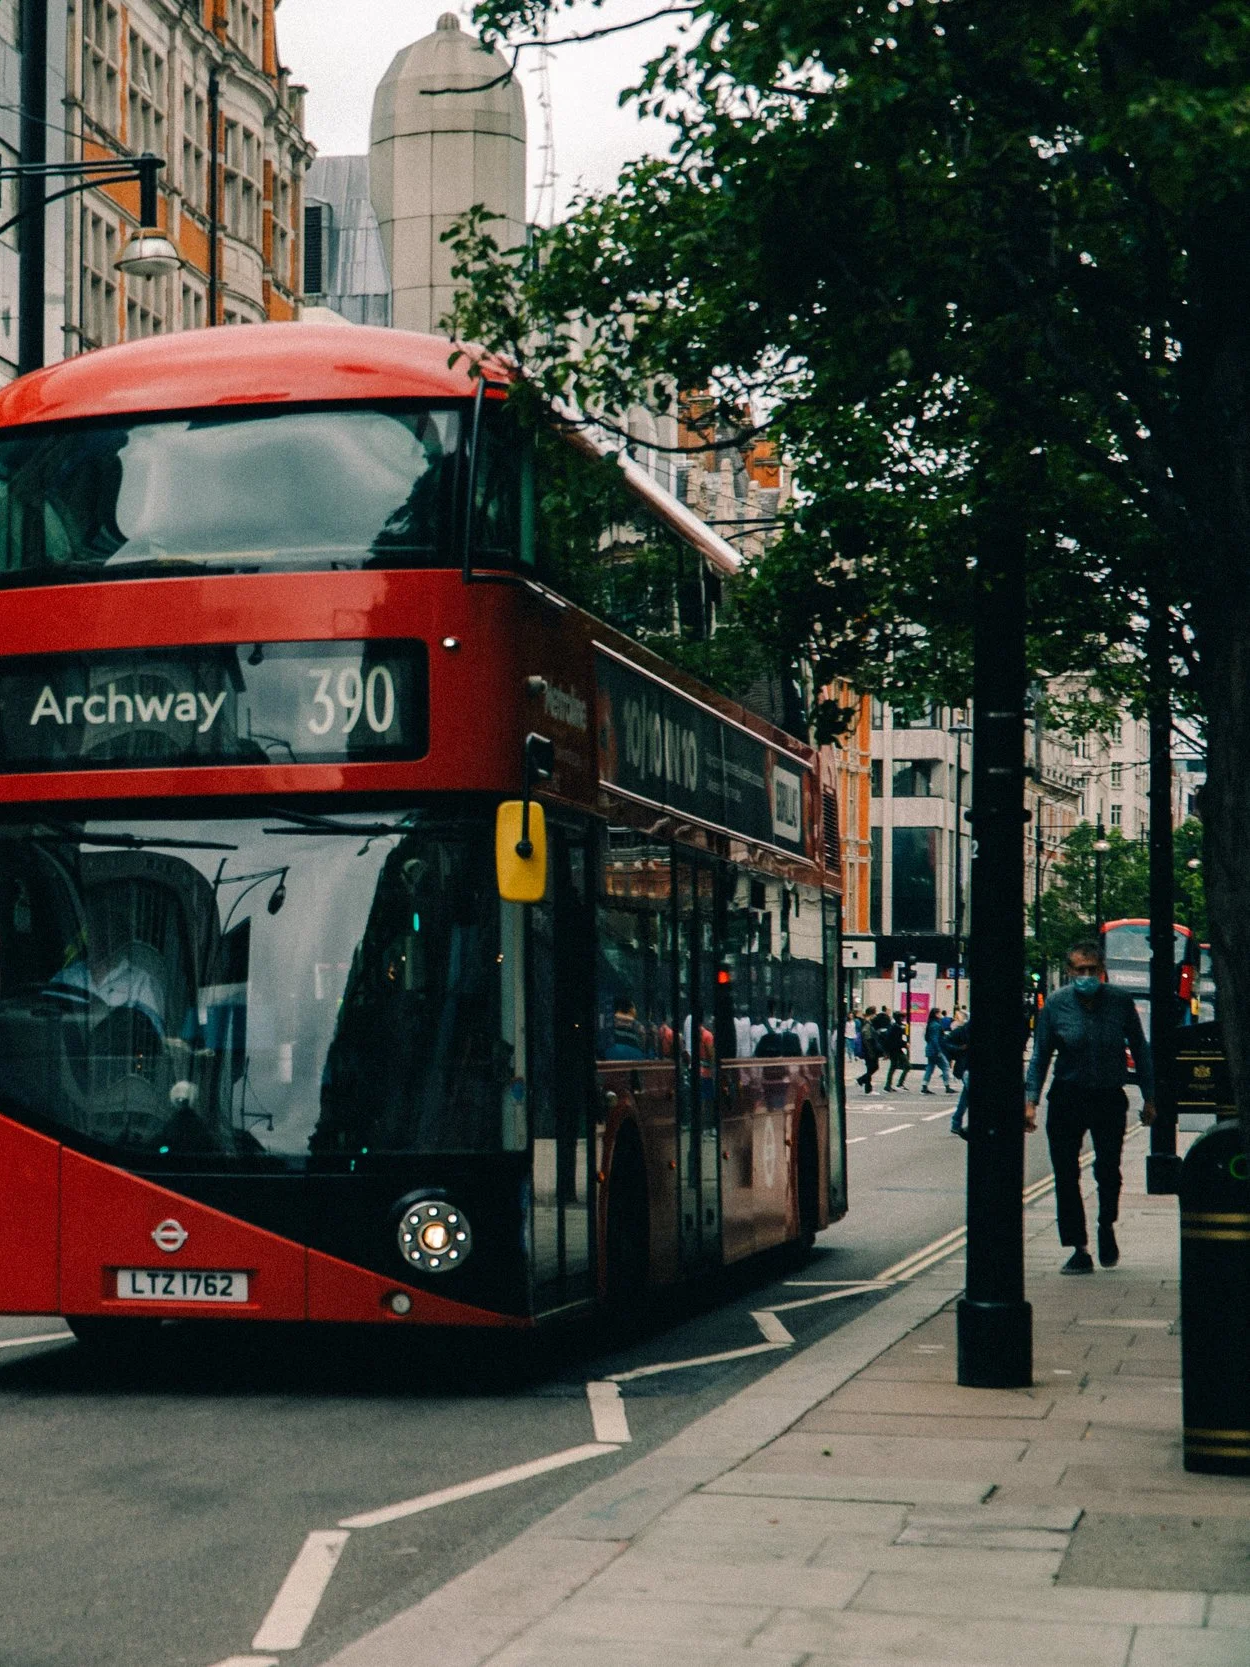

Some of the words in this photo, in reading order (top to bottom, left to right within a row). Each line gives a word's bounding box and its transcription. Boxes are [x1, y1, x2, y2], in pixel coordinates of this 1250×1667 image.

[29, 683, 228, 734] Archway
[307, 665, 395, 736] 390
[131, 1273, 176, 1296] LTZ
[182, 1275, 234, 1297] 1762
